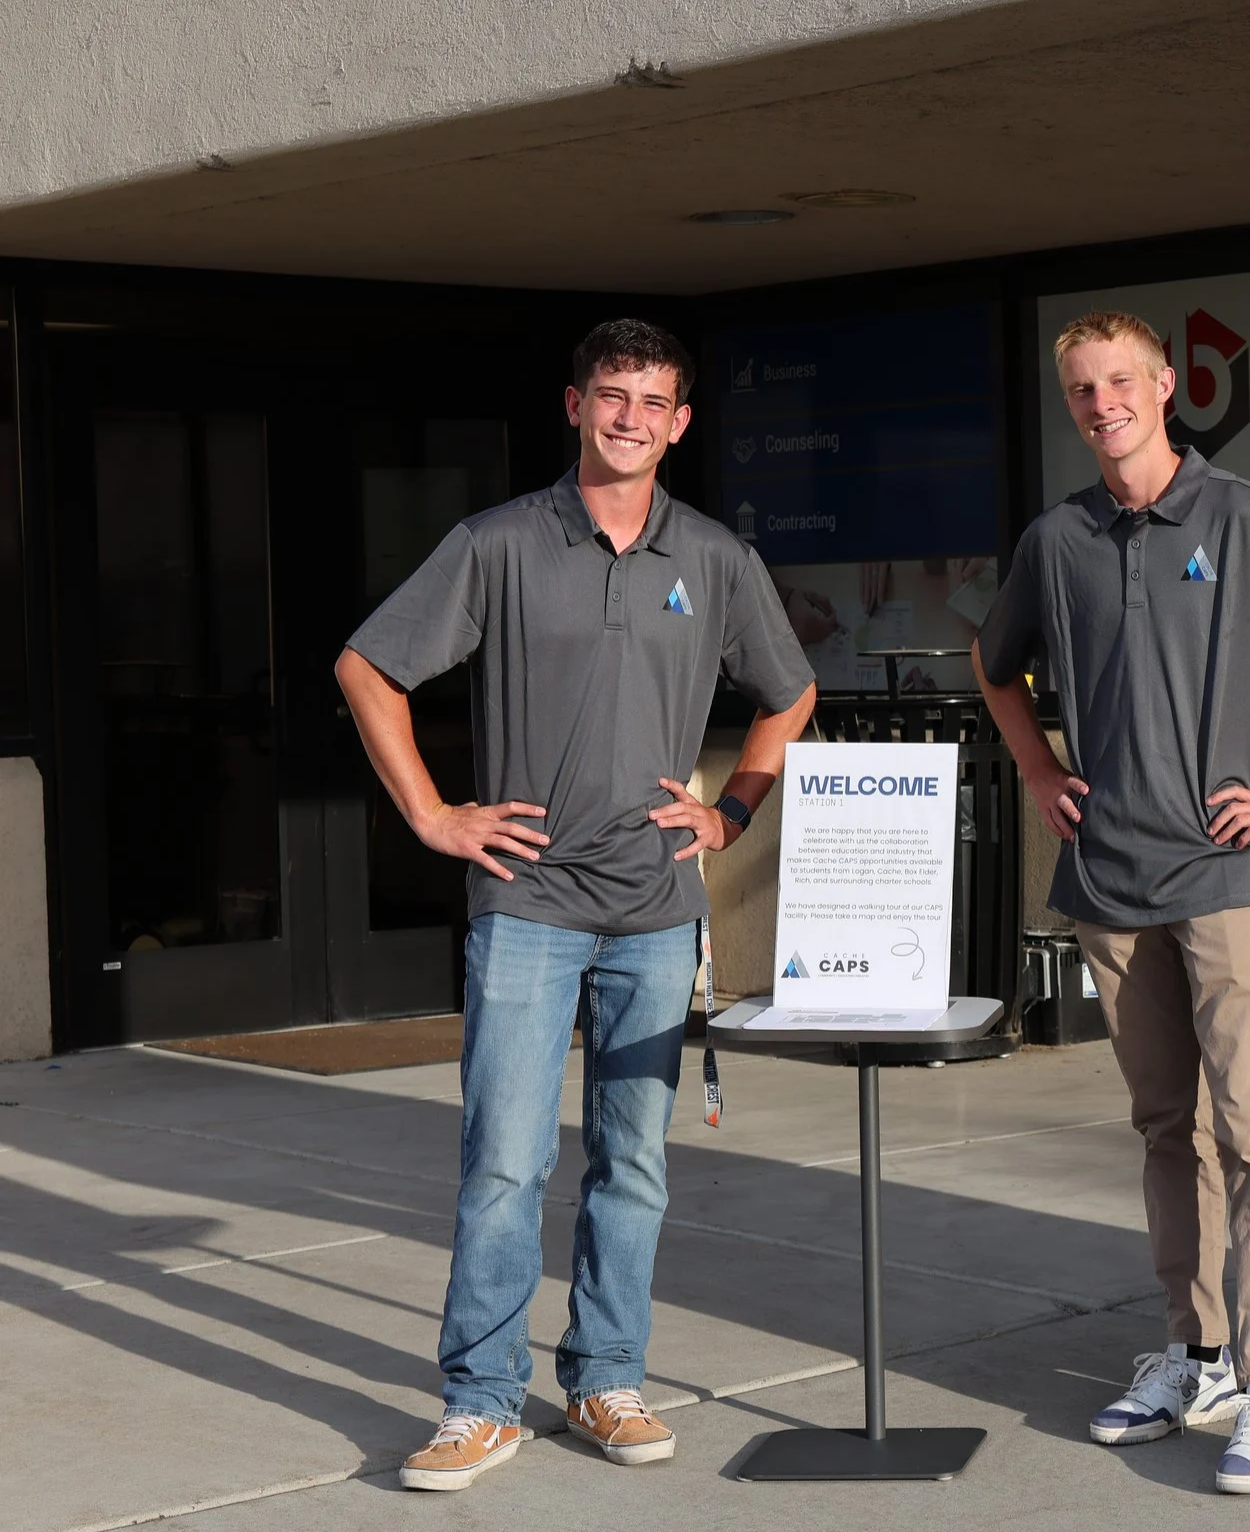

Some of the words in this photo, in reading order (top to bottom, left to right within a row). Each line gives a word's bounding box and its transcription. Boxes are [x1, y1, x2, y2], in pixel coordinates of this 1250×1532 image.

[763, 362, 817, 381] Business
[765, 430, 840, 453] Counseling
[767, 510, 836, 533] Contracting
[799, 775, 939, 797] WELCOME
[798, 798, 836, 807] STATION
[839, 798, 844, 807] 1
[887, 848, 916, 856] industry
[860, 858, 908, 866] opportunities
[830, 878, 874, 886] surrounding
[817, 903, 850, 911] designed
[858, 904, 885, 912] walking
[893, 914, 912, 922] enjoy
[818, 959, 869, 973] CAPS
